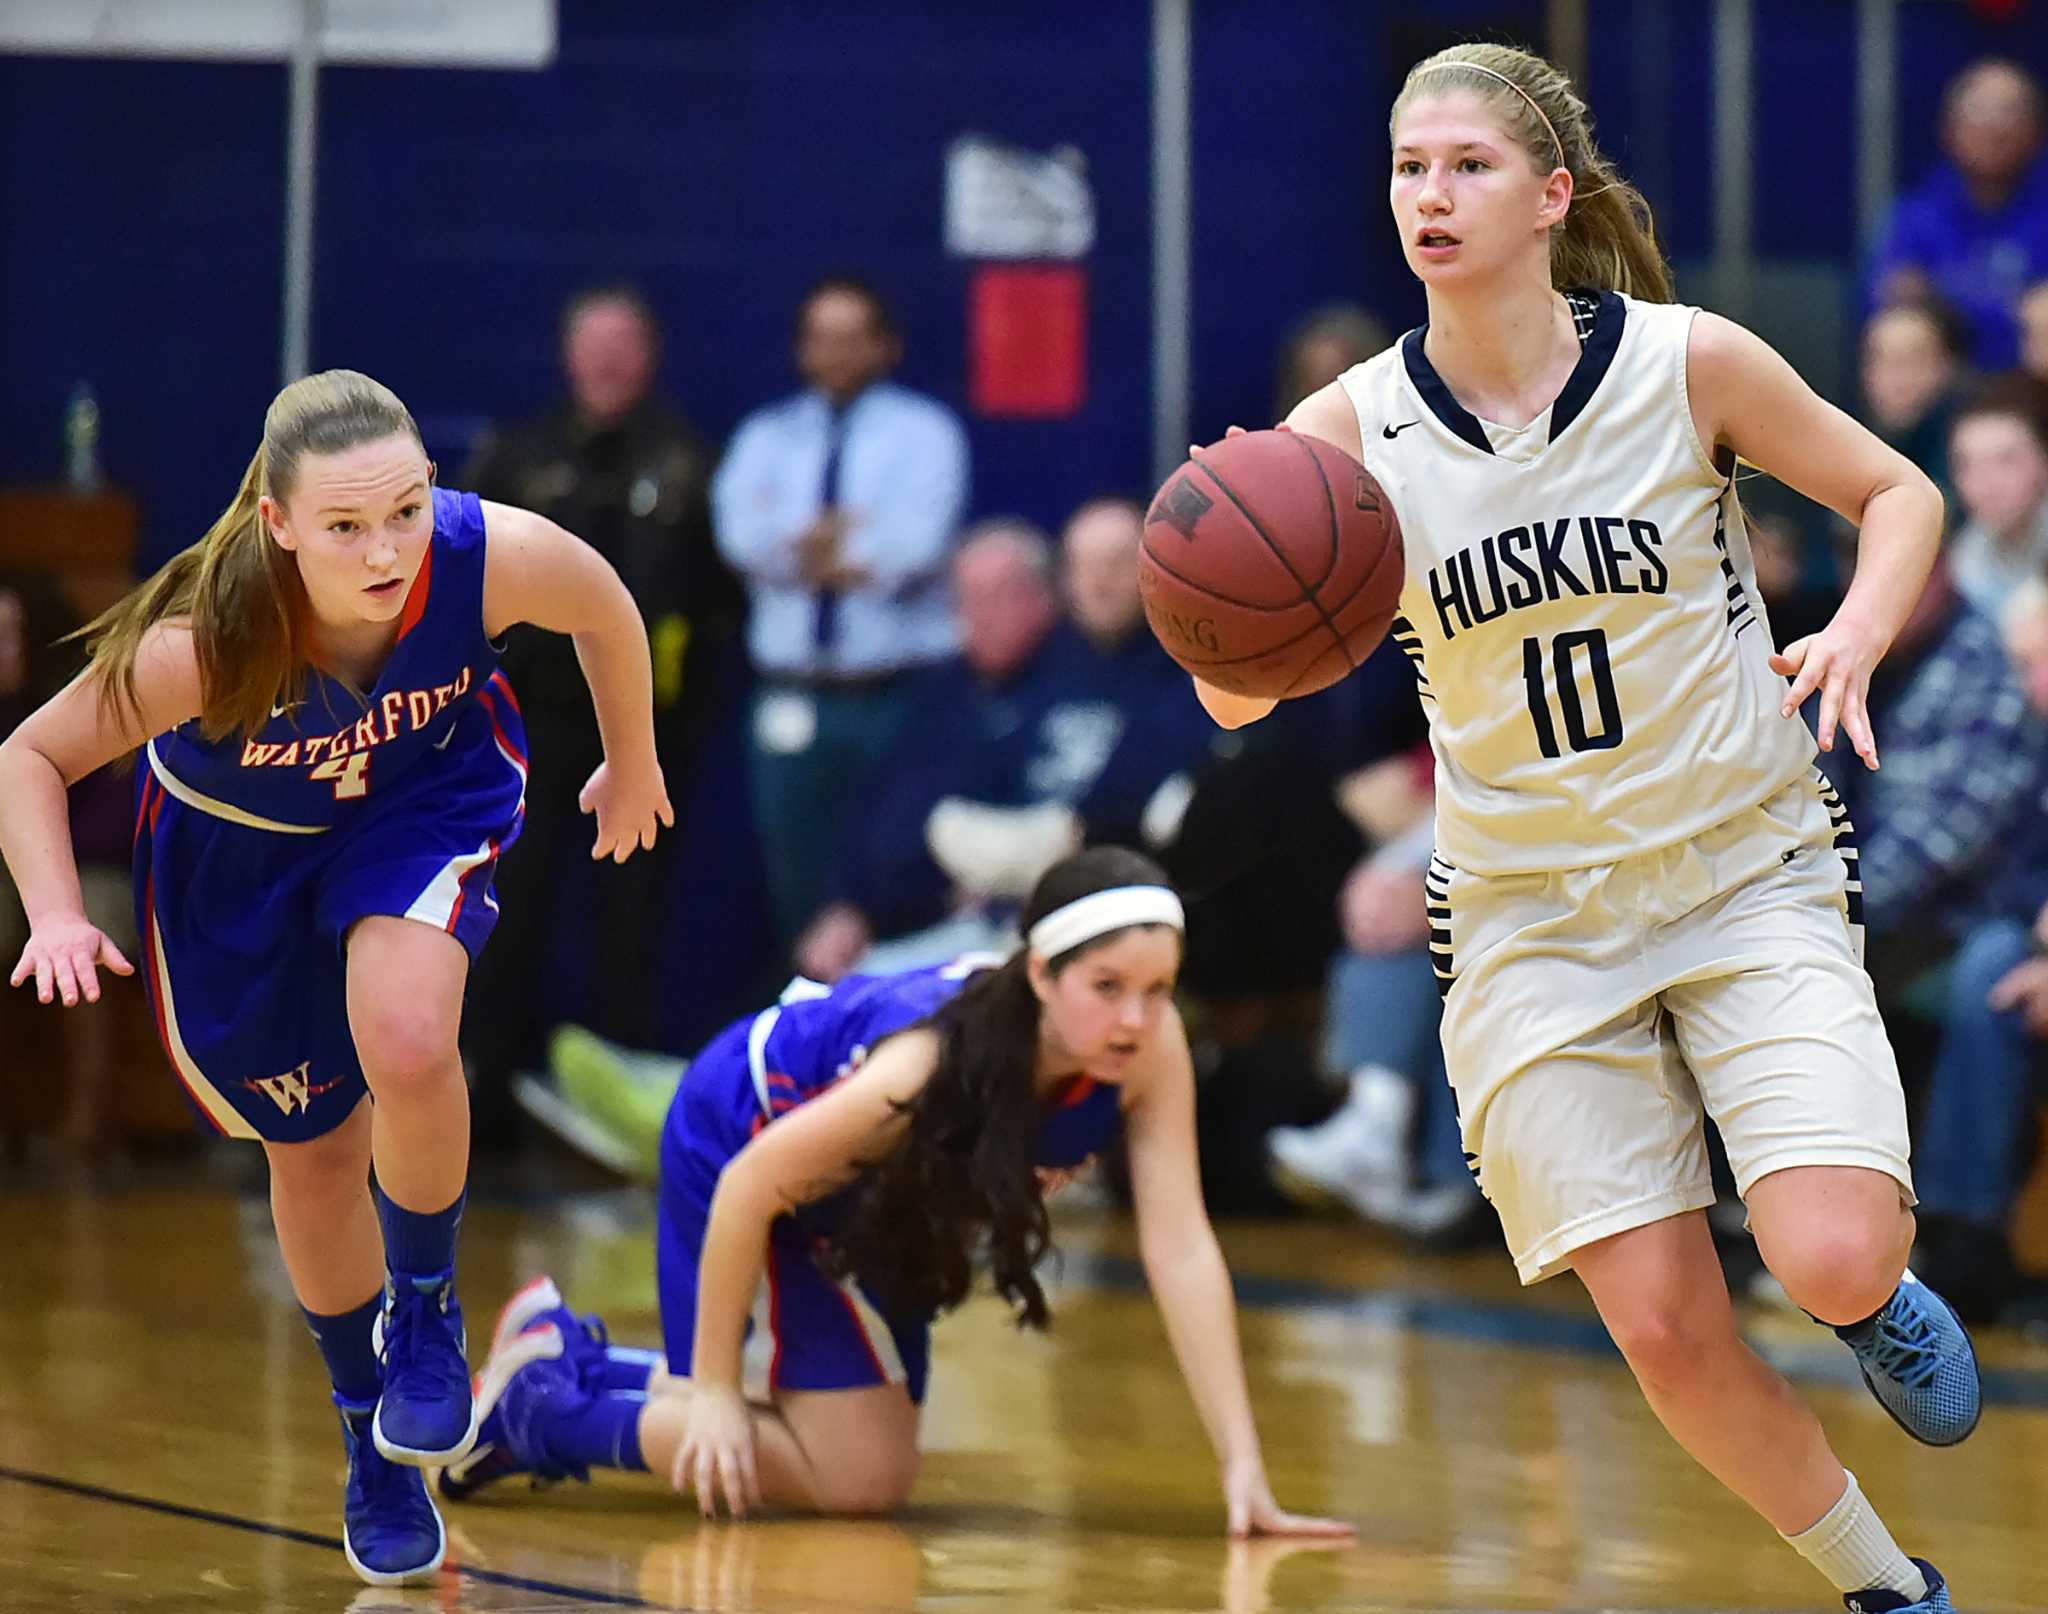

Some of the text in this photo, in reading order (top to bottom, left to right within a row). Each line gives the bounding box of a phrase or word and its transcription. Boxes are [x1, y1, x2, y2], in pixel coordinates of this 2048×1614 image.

[1428, 516, 1668, 640] HUSKIES
[1522, 628, 1624, 759] 10
[308, 750, 371, 800] 4
